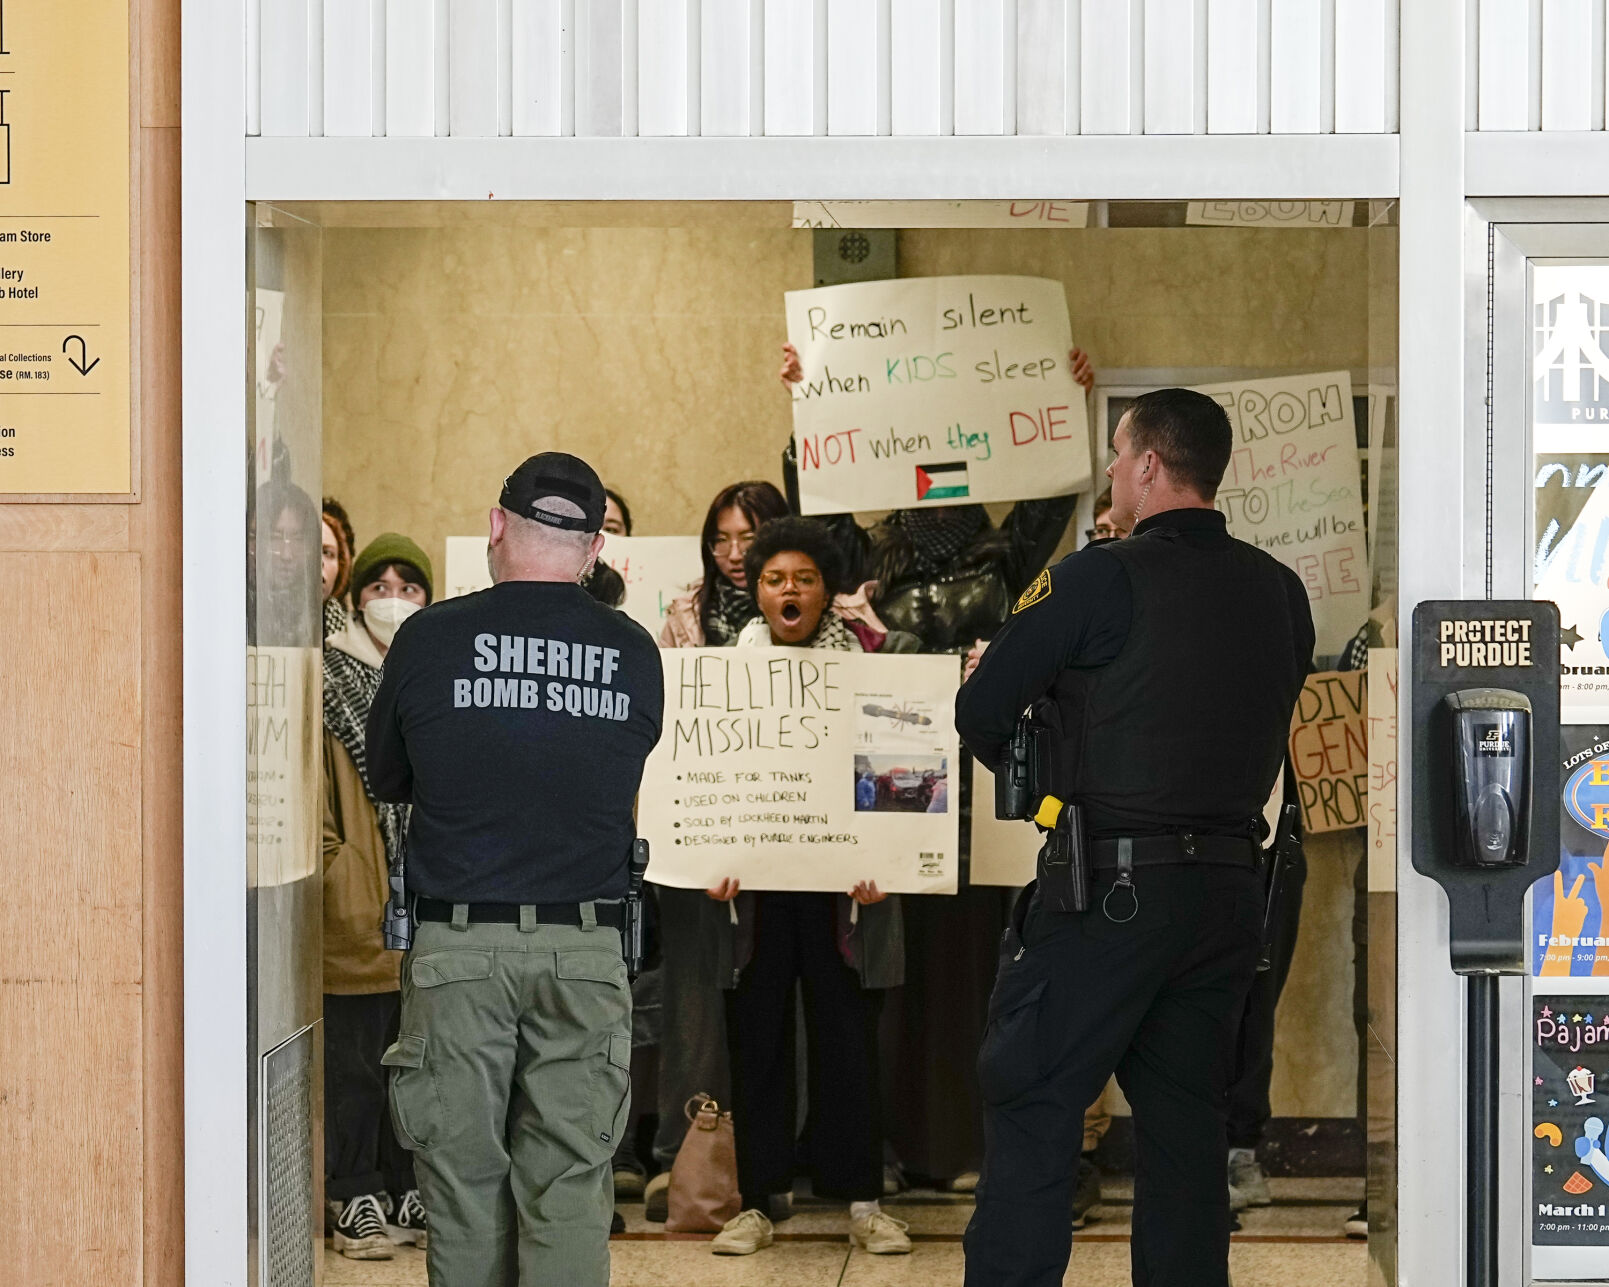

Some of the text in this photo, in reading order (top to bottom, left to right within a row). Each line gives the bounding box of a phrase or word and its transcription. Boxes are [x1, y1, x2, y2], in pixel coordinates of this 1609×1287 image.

[20, 230, 51, 242] Store
[1, 267, 24, 282] lery
[8, 286, 38, 299] Hotel
[808, 293, 1033, 341] Remain silent
[8, 353, 52, 362] Collections
[15, 371, 33, 380] (RM.
[34, 371, 50, 380] 183)
[800, 350, 1057, 399] when KIDS sleep
[1572, 407, 1609, 420] PUR
[802, 405, 1072, 471] NOT when they DIE
[1232, 442, 1338, 486] The River
[1216, 486, 1269, 524] TO
[1309, 477, 1351, 512] Sea
[1296, 518, 1327, 543] will
[1332, 515, 1360, 533] be
[1440, 620, 1532, 642] PROTECT
[474, 633, 620, 685] SHERIFF
[680, 656, 841, 712] HELLFIRE
[453, 677, 631, 722] BOMB SQUAD
[1299, 671, 1367, 723] DIV
[673, 715, 829, 761] MISSILES:
[1563, 748, 1594, 770] LOTS
[687, 771, 813, 784] MADE FOR TANKS
[684, 791, 807, 808] USED ON CHILDREN
[684, 817, 715, 828] SOLD
[738, 813, 790, 824] LOCKHEED
[793, 813, 828, 825] MARTIN
[684, 834, 738, 847] DESIGNED
[799, 832, 859, 846] ENGINEERS
[1538, 1203, 1594, 1216] March
[1539, 1223, 1556, 1231] 7:00
[1577, 1223, 1598, 1231] 11:00
